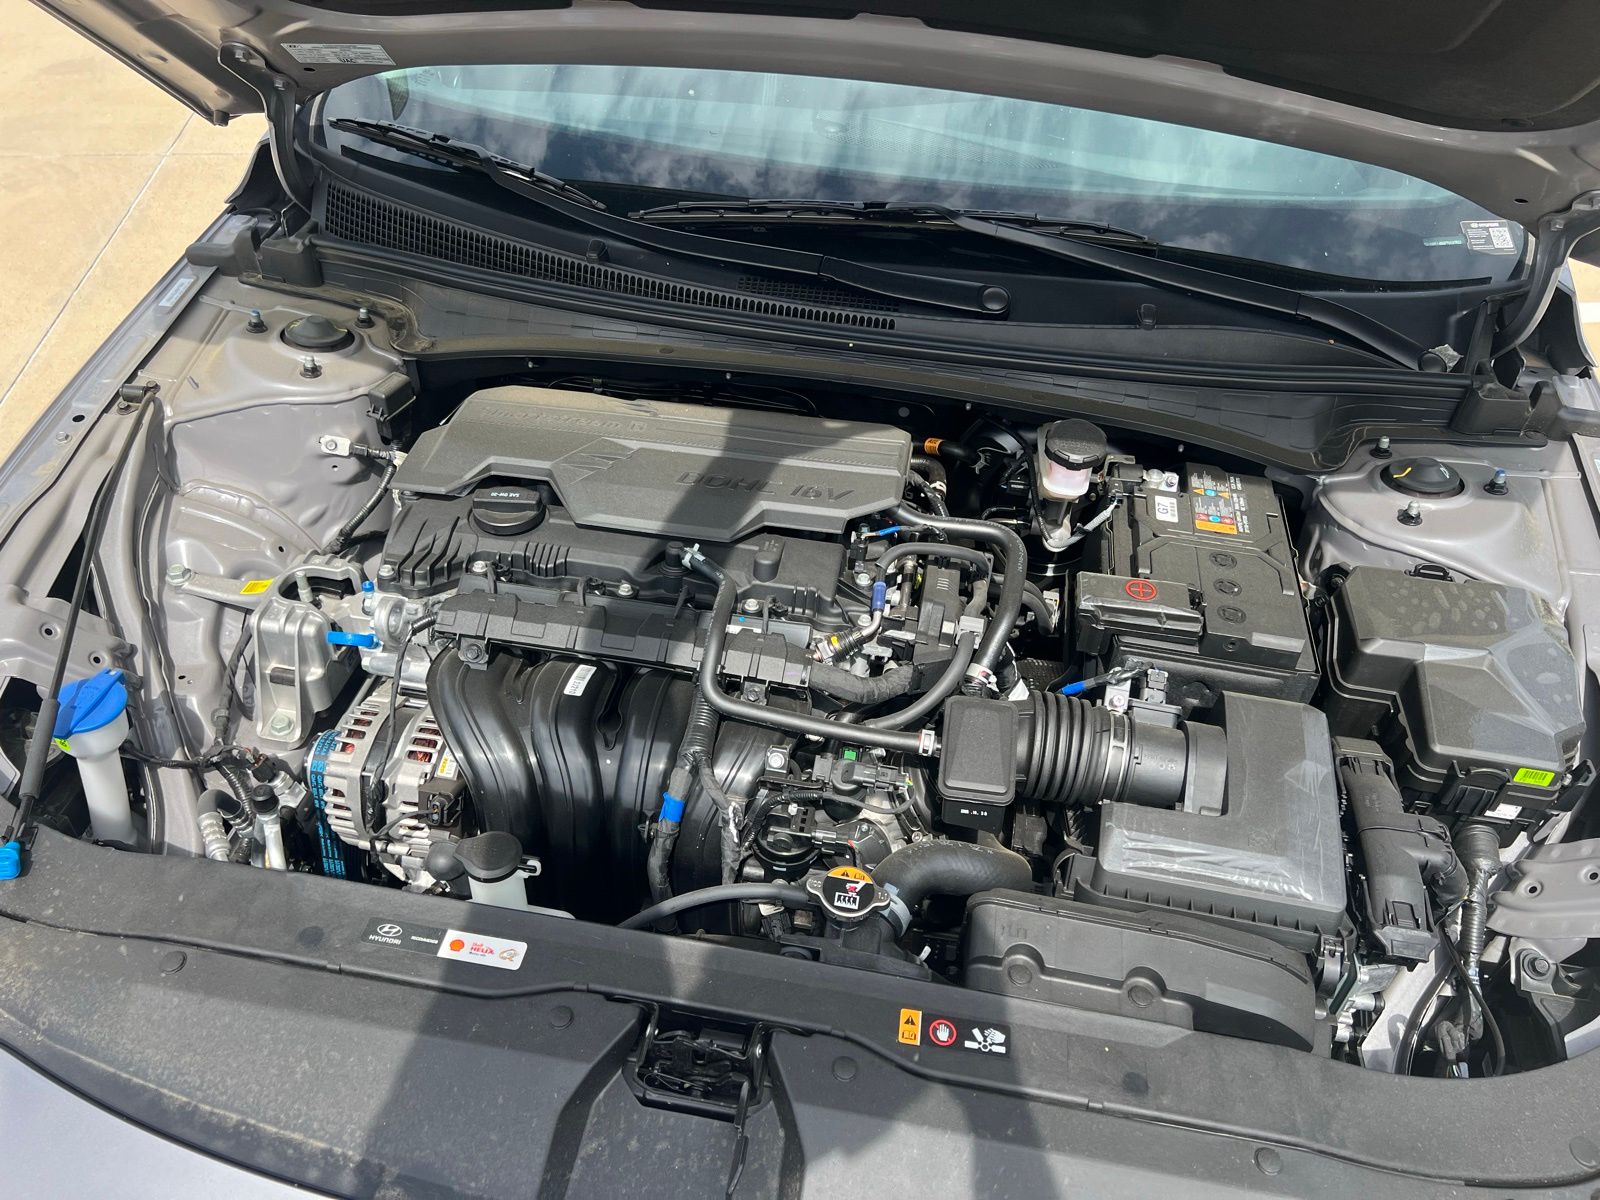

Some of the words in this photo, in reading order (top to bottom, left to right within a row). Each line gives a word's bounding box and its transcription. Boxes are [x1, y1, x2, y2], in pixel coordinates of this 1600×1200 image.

[675, 471, 783, 496] DOHC
[790, 484, 855, 502] 16V
[1157, 502, 1169, 515] G7
[368, 934, 402, 945] HYUNDAI
[470, 946, 495, 955] HELIX
